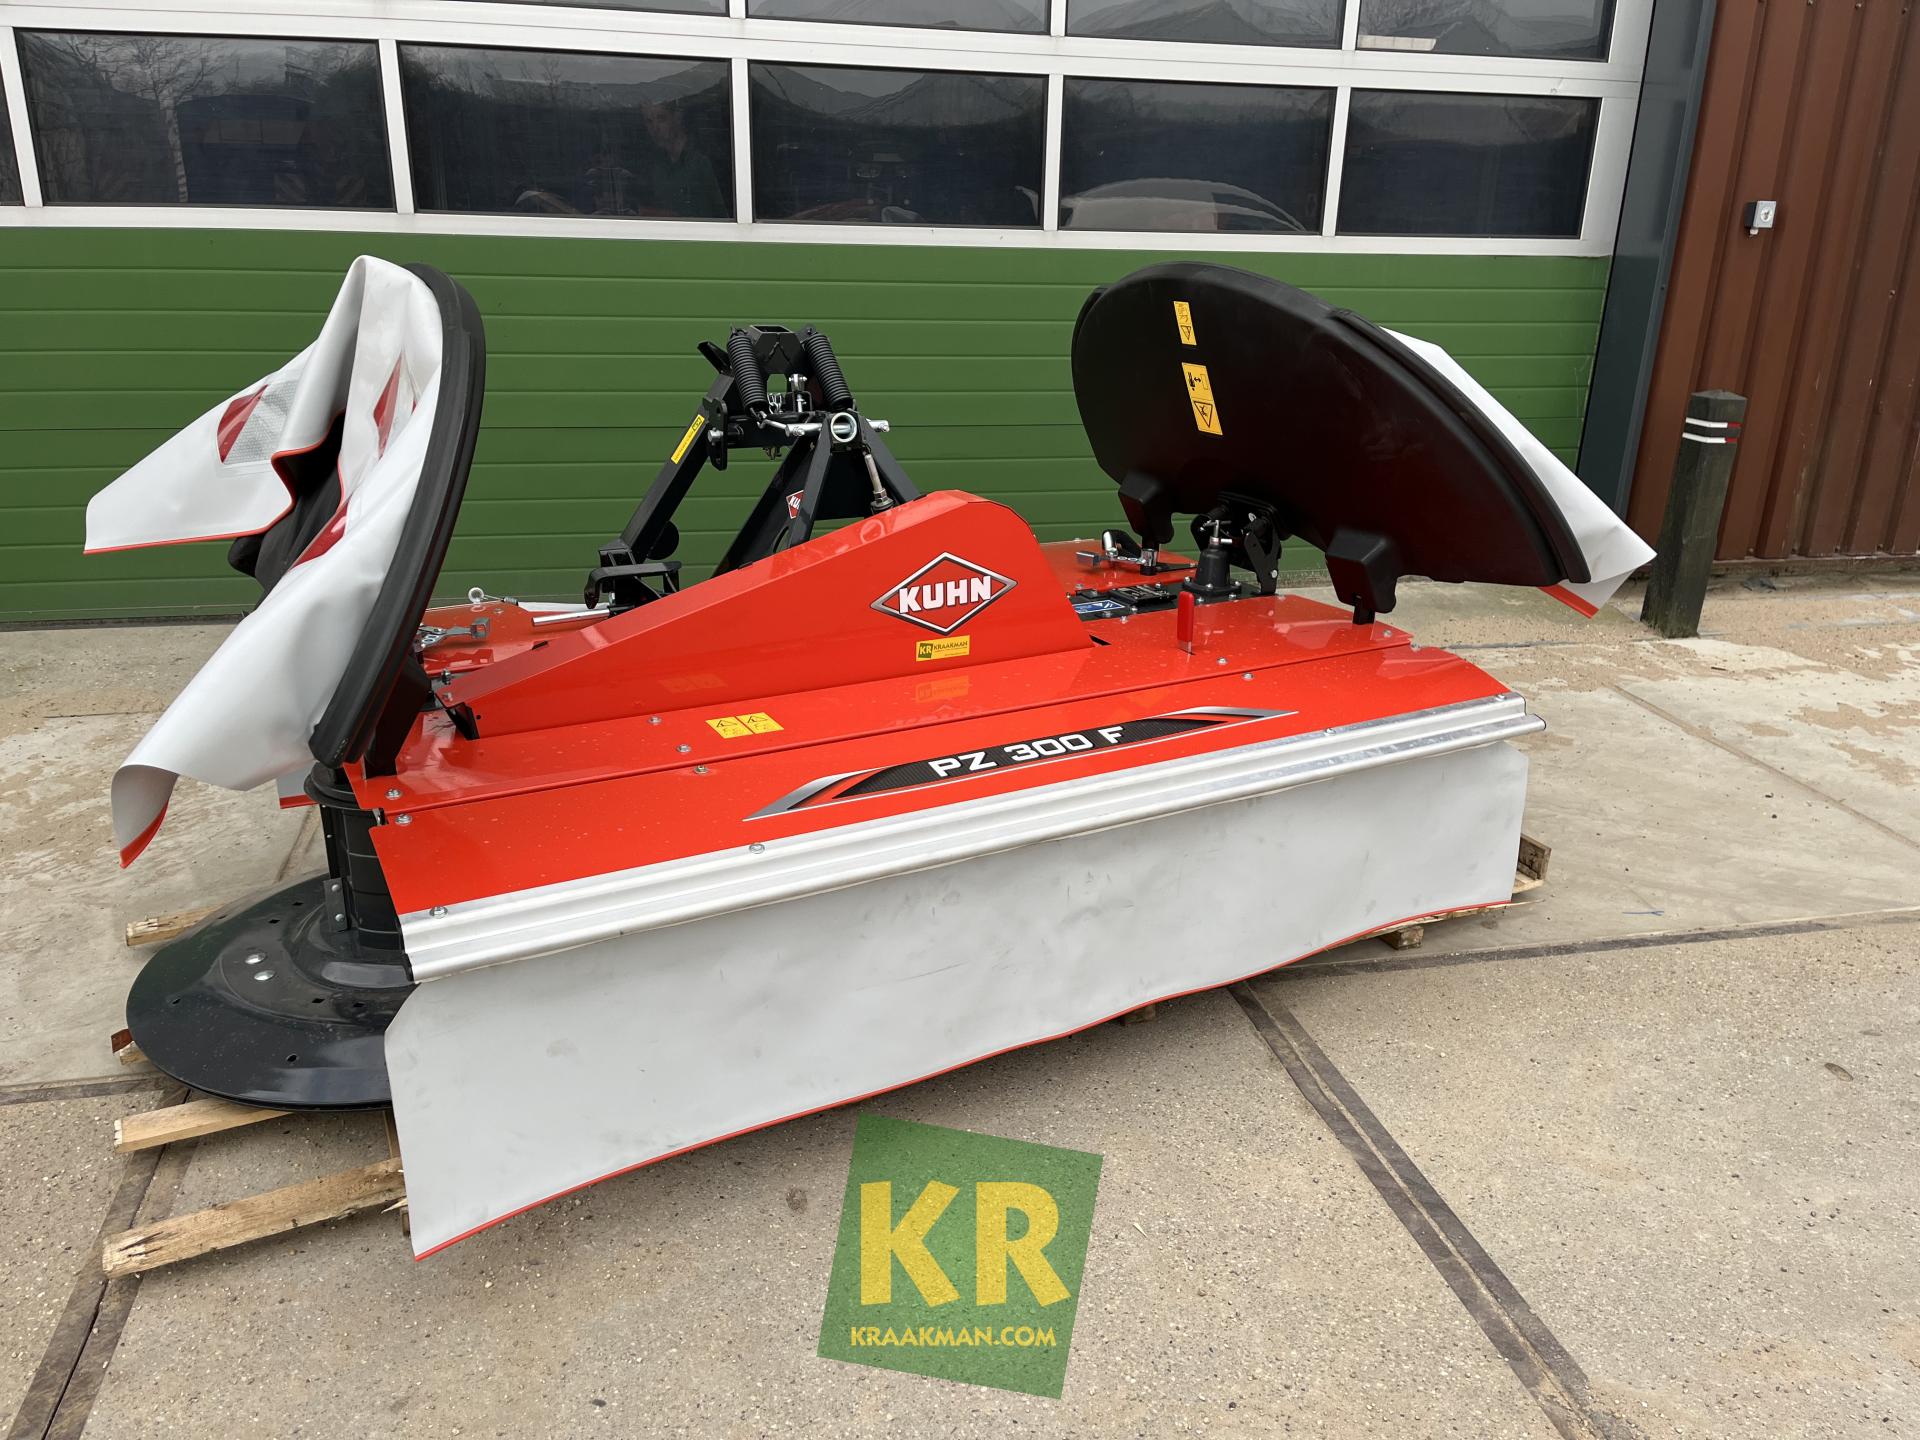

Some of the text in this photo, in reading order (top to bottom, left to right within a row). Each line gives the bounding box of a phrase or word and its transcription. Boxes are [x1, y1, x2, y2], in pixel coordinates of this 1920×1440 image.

[899, 575, 992, 615] KUHN
[919, 645, 932, 655] KR
[933, 640, 968, 650] KRAAKMAN
[928, 726, 1124, 777] PZ 300 F
